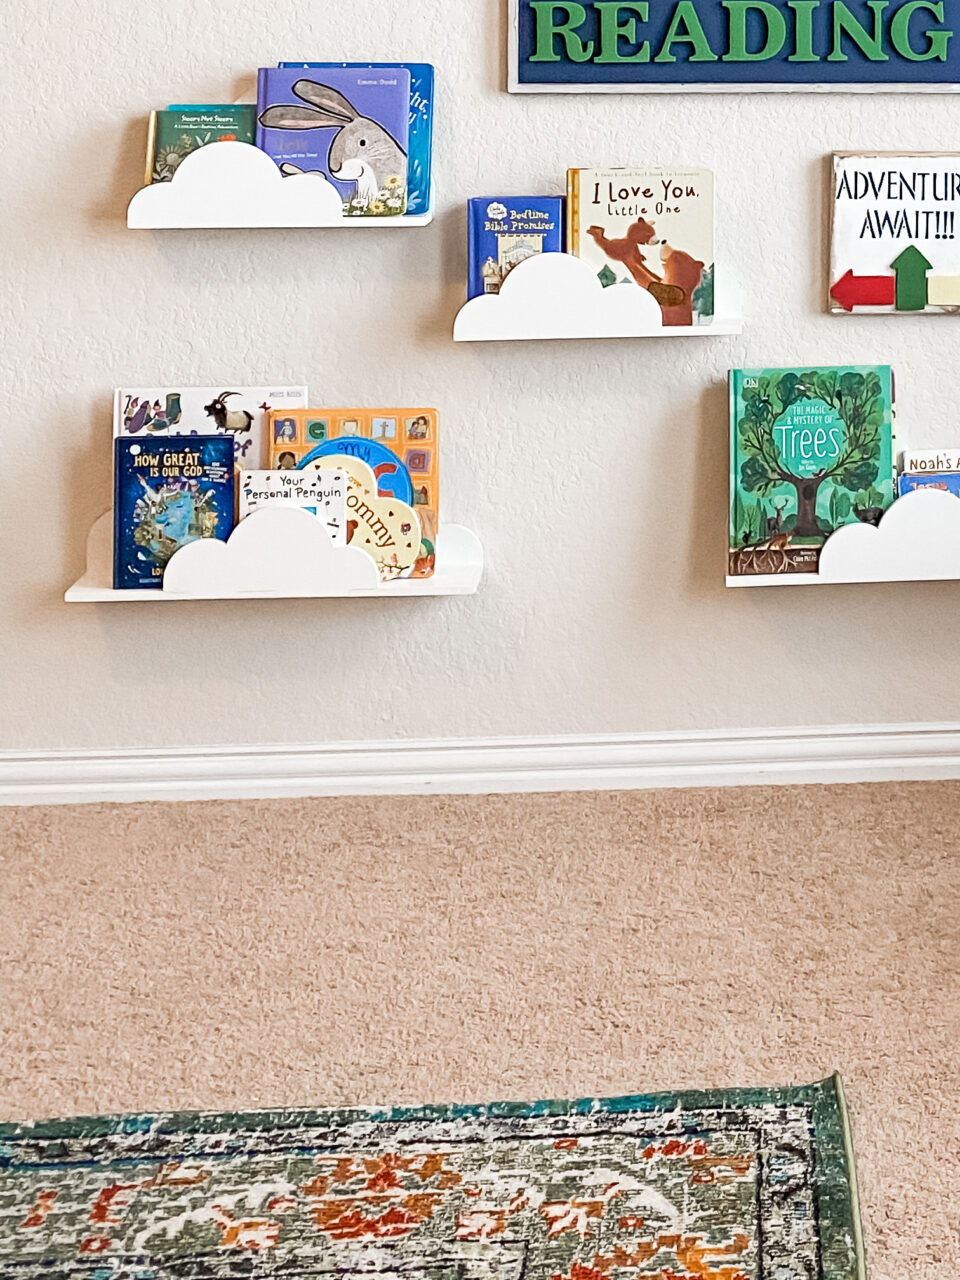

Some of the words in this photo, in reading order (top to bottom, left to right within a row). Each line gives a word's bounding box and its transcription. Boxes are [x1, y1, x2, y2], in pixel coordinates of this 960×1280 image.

[529, 0, 953, 63] READING
[592, 182, 601, 204] I
[609, 182, 654, 203] Love
[661, 179, 700, 201] You,
[509, 209, 549, 220] Bedtime
[655, 202, 681, 215] One
[484, 221, 509, 231] Bible
[510, 221, 555, 231] Promises
[859, 208, 955, 240] AWAIT!!!
[806, 405, 826, 415] MAGIC
[774, 425, 840, 459] Trees
[133, 454, 160, 467] HOW
[163, 453, 200, 466] GREAT
[909, 453, 951, 470] Noah's
[150, 468, 159, 477] IS
[162, 467, 179, 477] OUR
[183, 466, 203, 476] GOD
[280, 476, 305, 487] Your
[244, 488, 292, 500] Personal
[296, 486, 342, 502] Penguin
